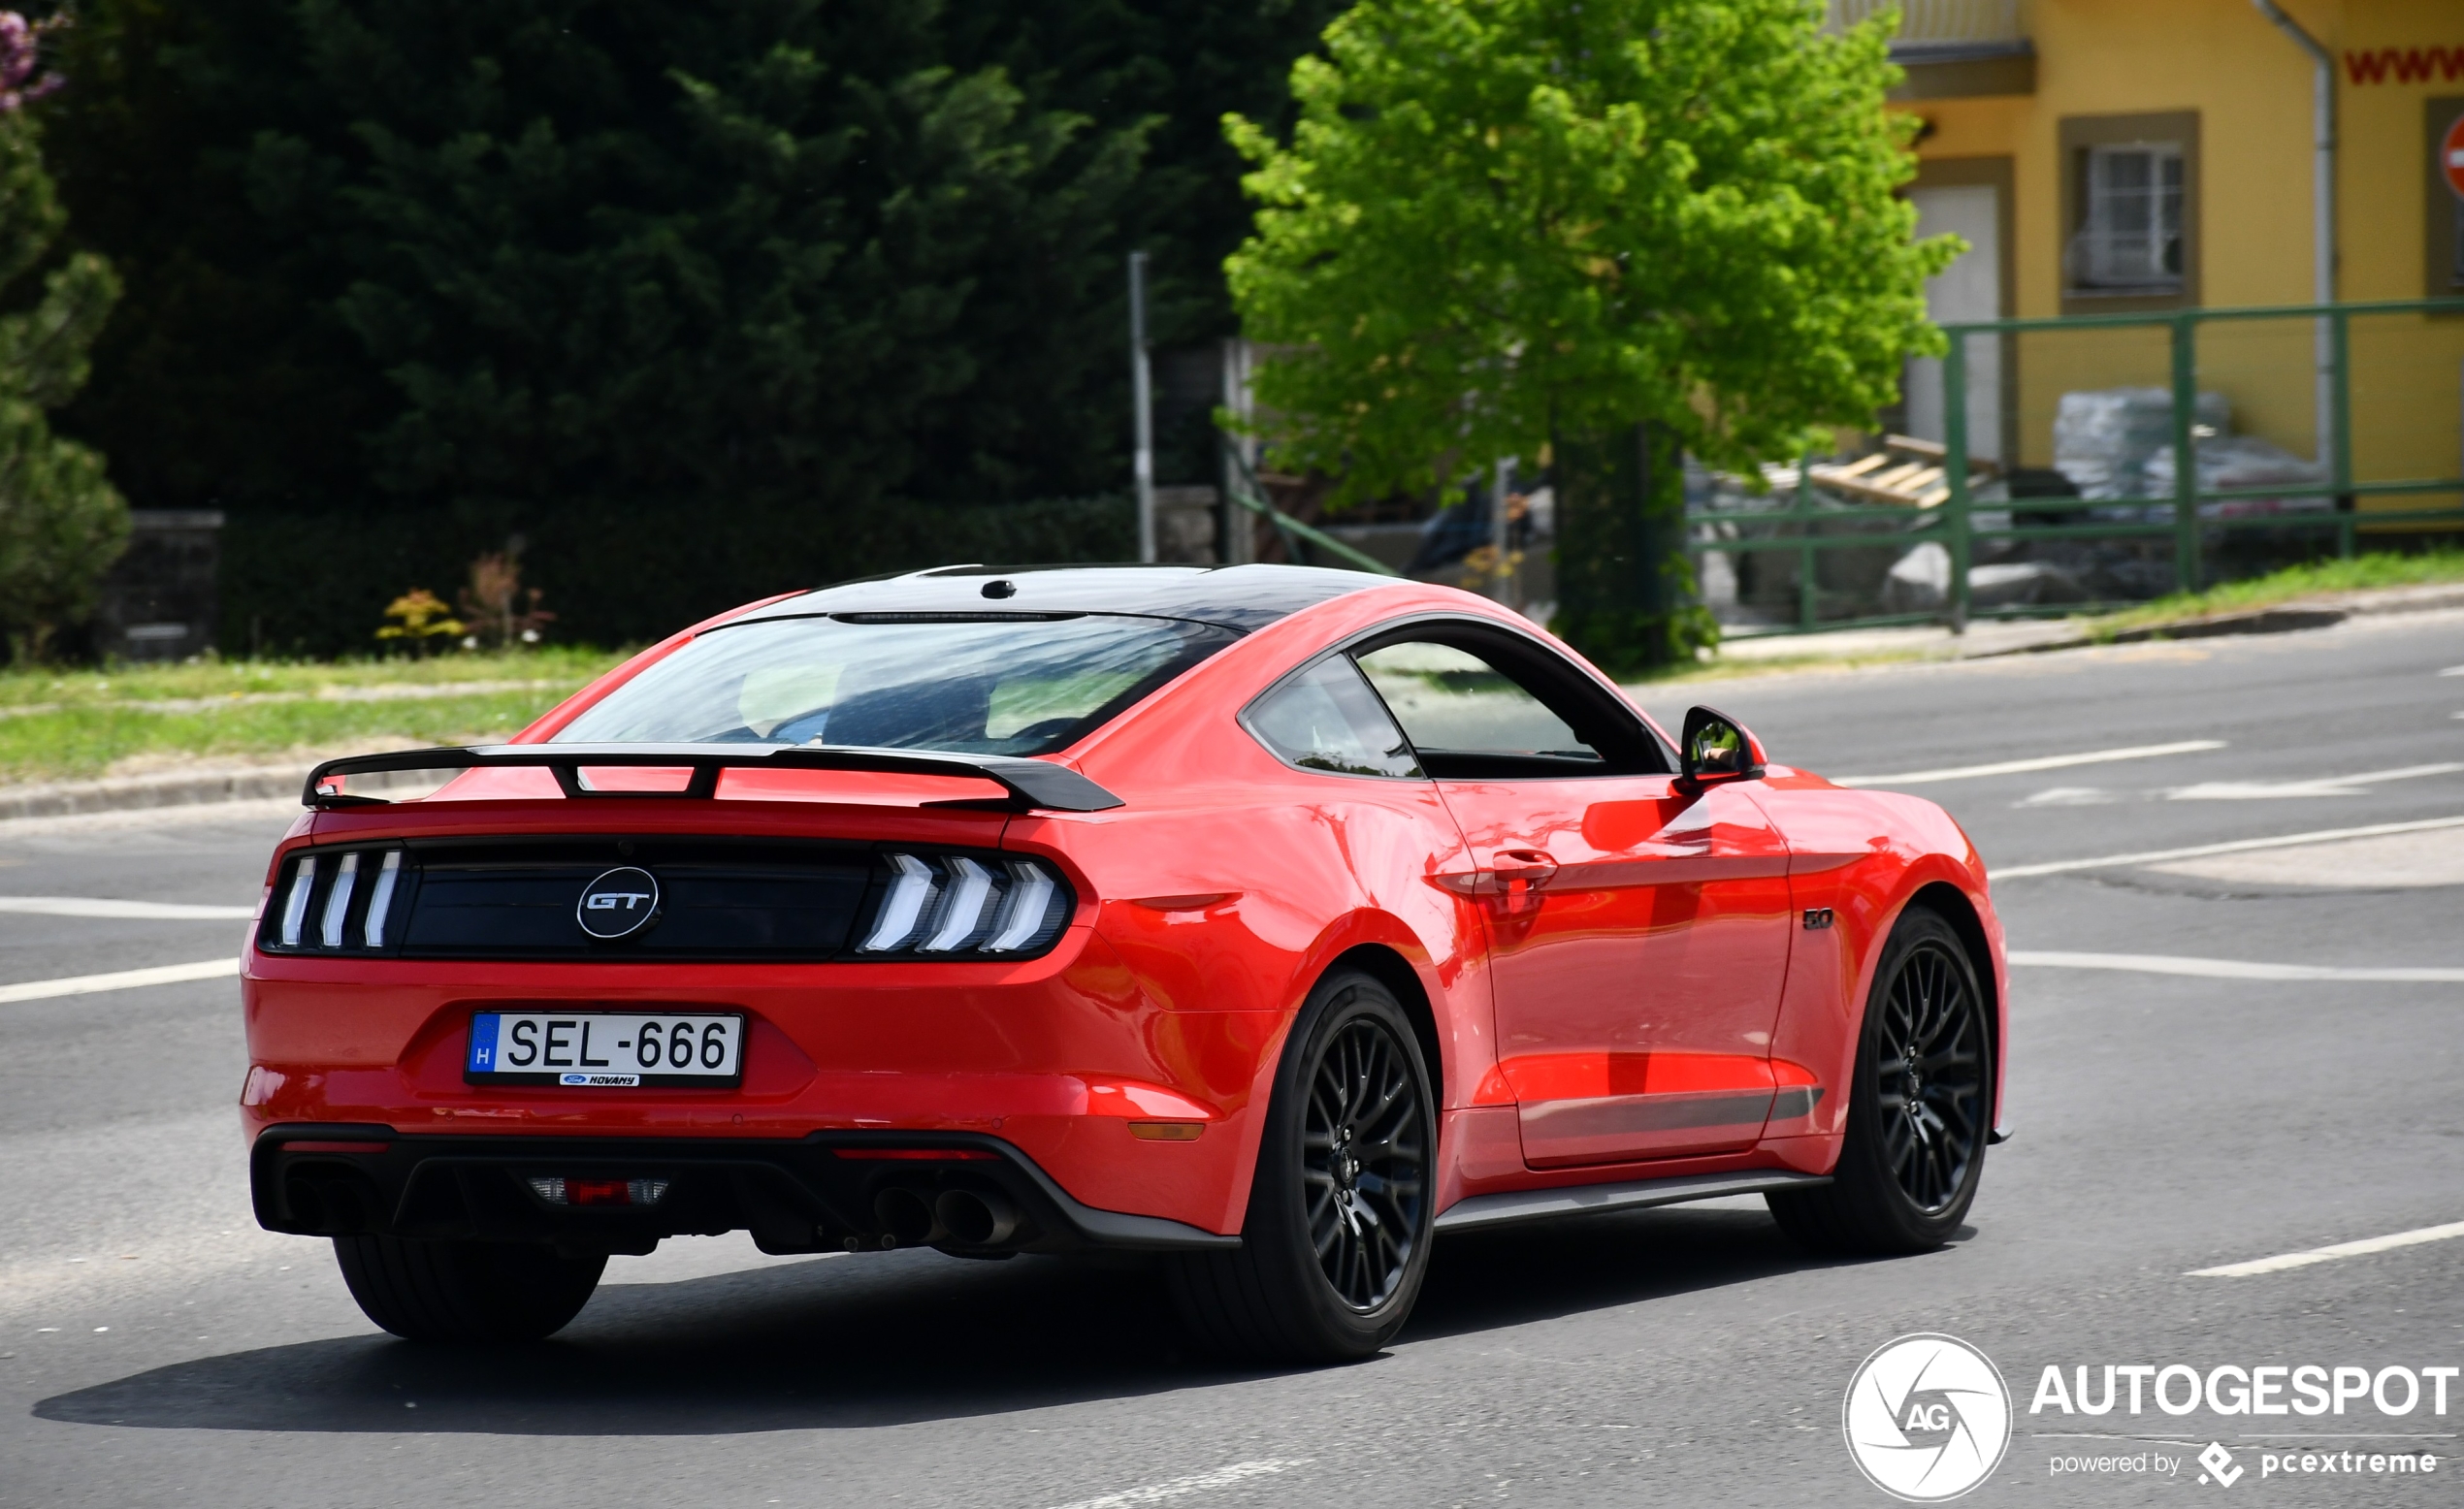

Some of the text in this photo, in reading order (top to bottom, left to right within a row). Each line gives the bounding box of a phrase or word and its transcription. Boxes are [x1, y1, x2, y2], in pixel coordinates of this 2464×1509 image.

[586, 892, 651, 911] GT
[476, 1019, 727, 1070] H SEL-666
